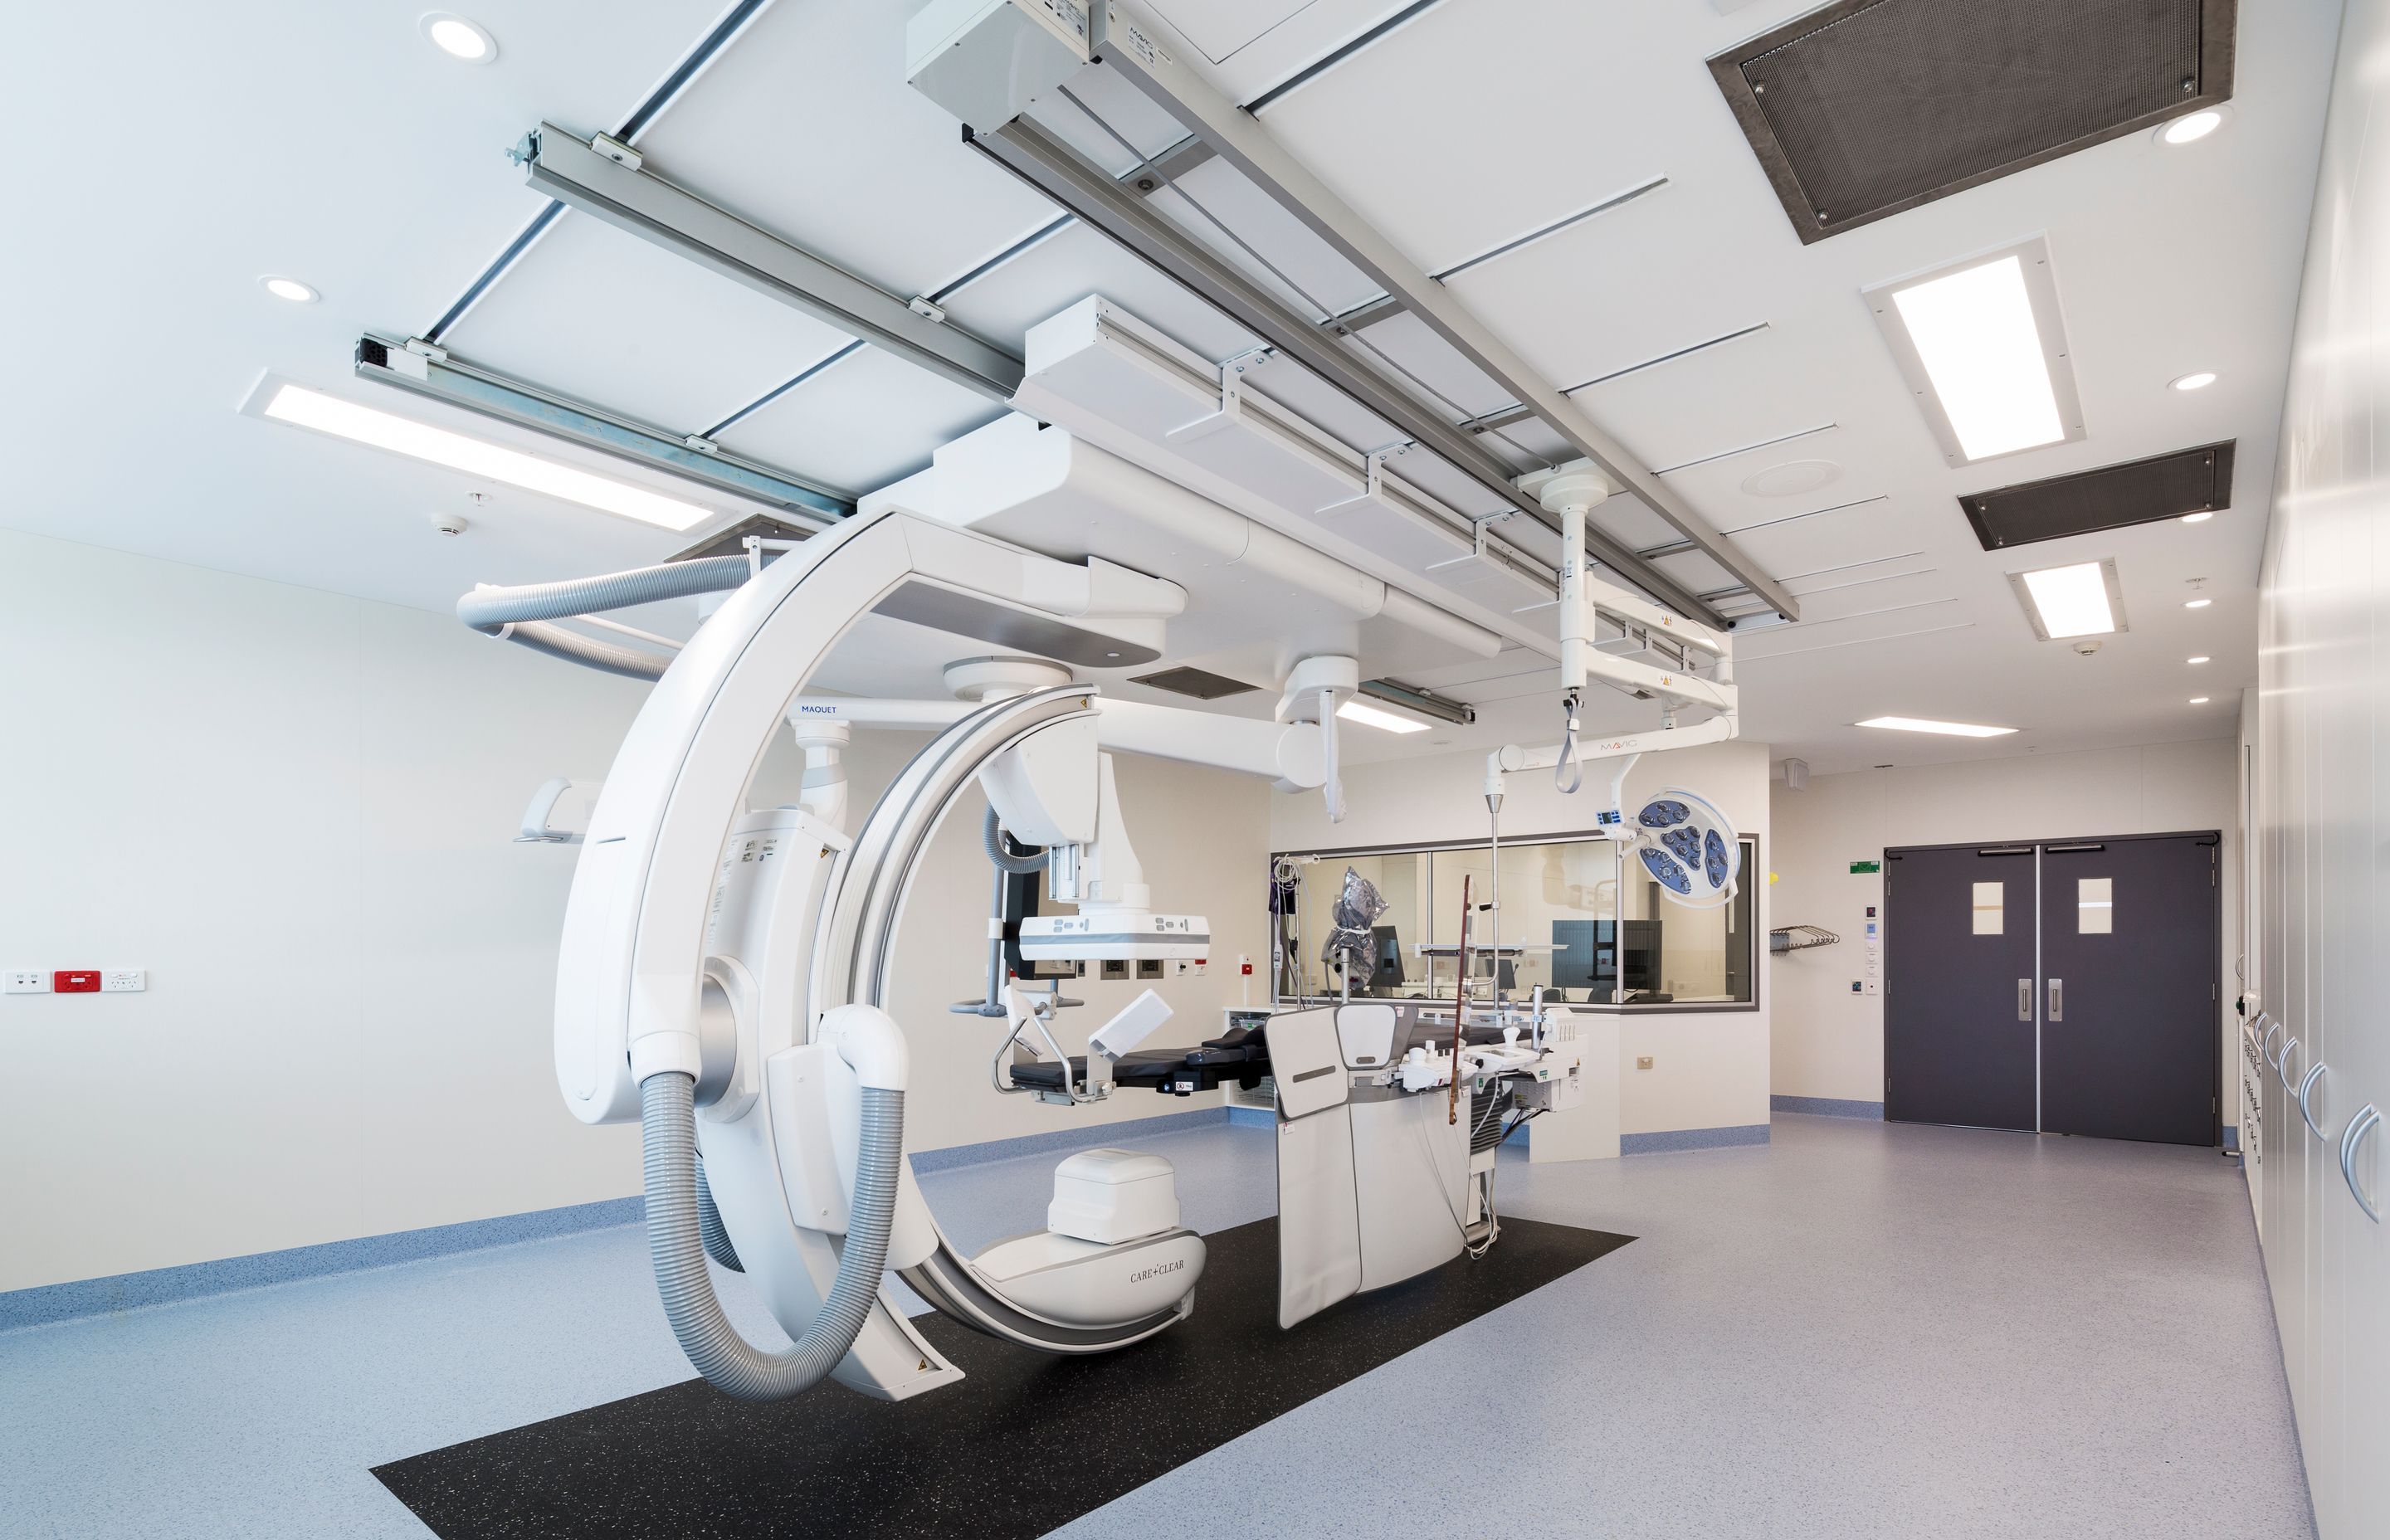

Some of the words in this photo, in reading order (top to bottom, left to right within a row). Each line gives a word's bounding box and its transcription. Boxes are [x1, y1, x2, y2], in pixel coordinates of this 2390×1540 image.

[1129, 27, 1154, 50] MAVIG
[802, 705, 836, 714] MAQUET
[1600, 739, 1638, 751] MAVIG
